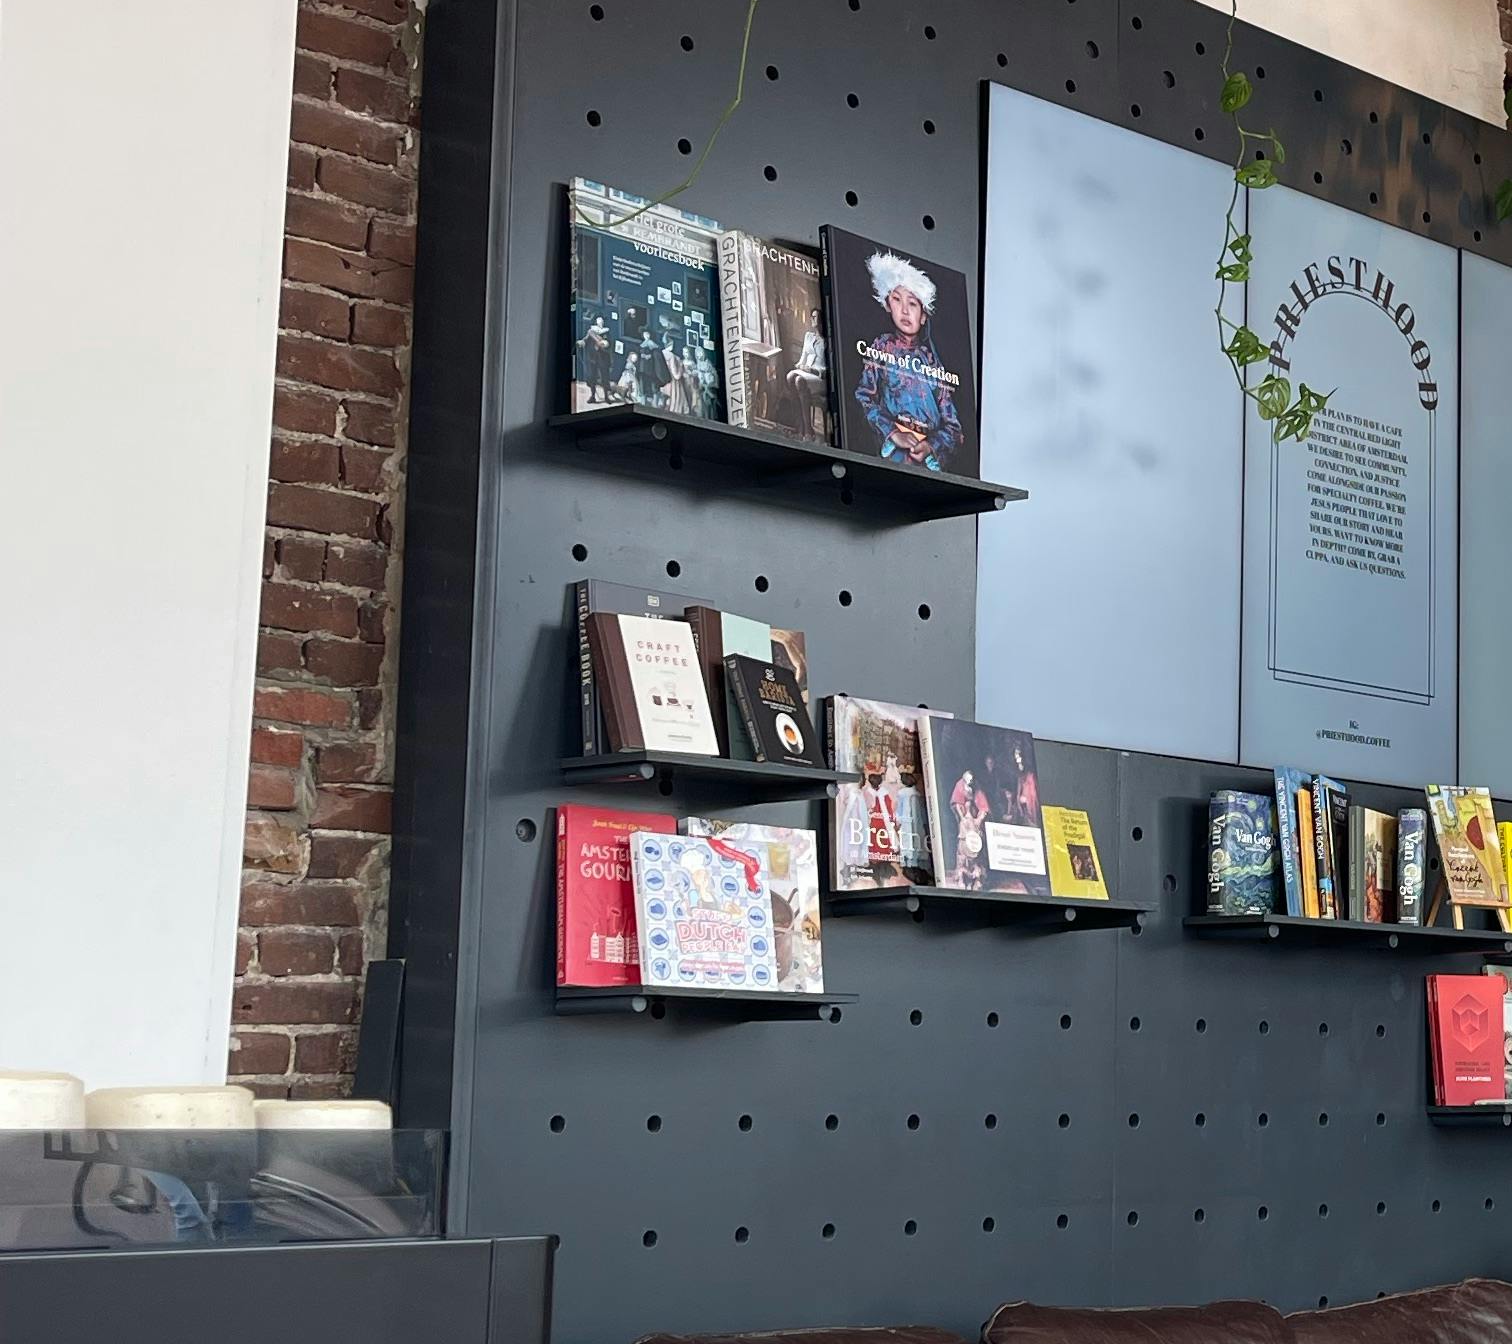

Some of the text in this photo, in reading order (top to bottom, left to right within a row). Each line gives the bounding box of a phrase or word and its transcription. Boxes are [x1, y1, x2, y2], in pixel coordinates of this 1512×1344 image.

[633, 227, 700, 254] REMBRANDT
[656, 221, 686, 238] grote
[633, 242, 706, 272] voorleesboek
[1268, 255, 1439, 411] PRIESTHOOD
[856, 340, 896, 365] Crown
[898, 355, 911, 370] of
[911, 357, 960, 386] Creation
[1353, 416, 1363, 426] TO
[1313, 418, 1401, 450] IN THE CENTRAL RED LIGHT
[1339, 438, 1356, 450] AREA
[1357, 443, 1366, 452] OF
[1307, 442, 1319, 454] WE
[1319, 445, 1344, 460] DESIRE
[1344, 452, 1354, 462] TO
[1355, 455, 1367, 467] SEE
[1306, 469, 1407, 502] COME ALONGSIDE OUR PASSION
[1360, 470, 1373, 481] AND
[1307, 483, 1321, 495] FOR
[1322, 486, 1358, 504] SPECIALTY
[1310, 497, 1403, 527] JESUS PEOPLE THAT LOVE TO
[1310, 510, 1403, 540] SHARE OUR STORY AND HEAR
[1312, 537, 1320, 547] IN
[1347, 545, 1366, 557] COME
[1377, 552, 1395, 564] GRAB
[1333, 529, 1353, 542] WANT
[1354, 533, 1364, 544] TO
[1364, 535, 1384, 549] KNOW
[1384, 542, 1404, 553] MORE
[1330, 554, 1345, 566] AND
[1345, 559, 1359, 569] ASK
[1359, 562, 1368, 571] US
[636, 639, 681, 654] CRAFT
[580, 653, 593, 687] BOOK
[635, 653, 690, 668] COFFEE
[1312, 778, 1325, 860] VINCENT VAN GOGH
[1234, 828, 1277, 850] Van Gogh
[580, 843, 631, 864] AMSTE
[1207, 813, 1227, 893] Van Gogh
[580, 861, 632, 882] GOUR
[1399, 831, 1419, 906] Van Gogh
[676, 921, 747, 943] DUTCH
